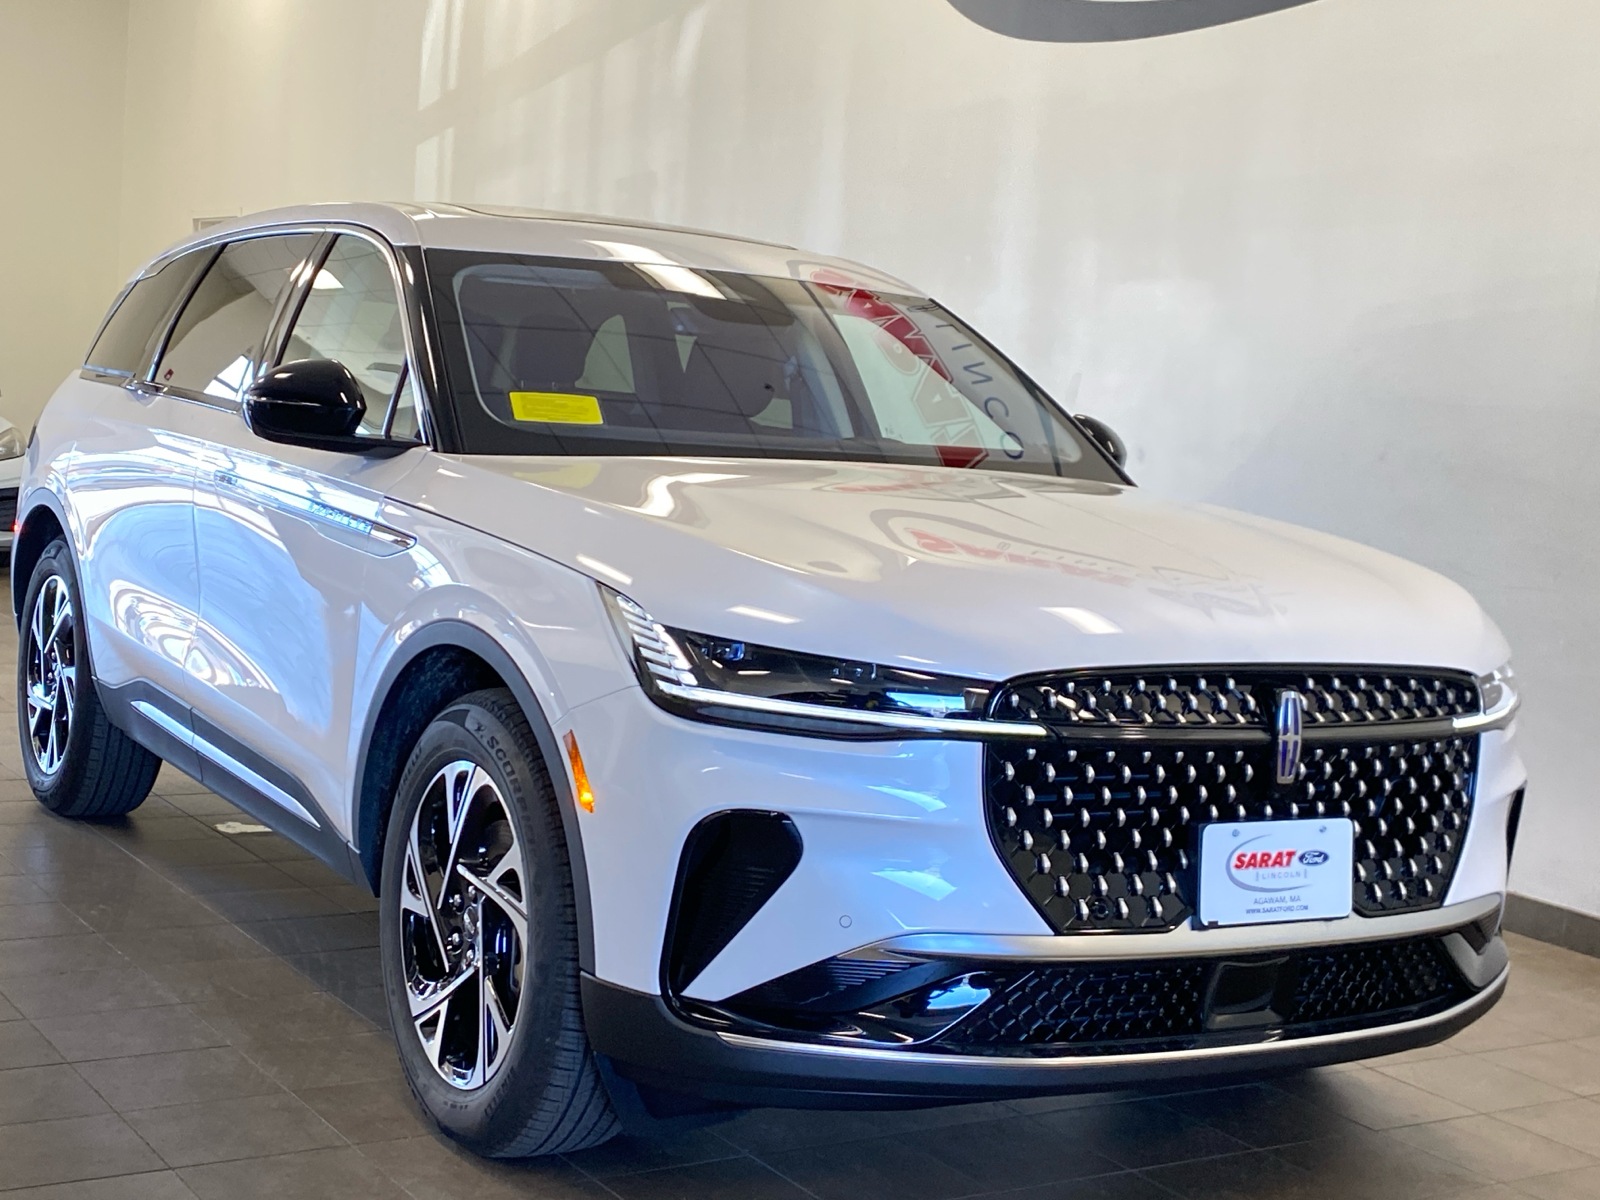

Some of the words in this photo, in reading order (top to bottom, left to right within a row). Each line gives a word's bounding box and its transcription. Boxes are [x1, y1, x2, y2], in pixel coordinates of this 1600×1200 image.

[485, 734, 537, 850] SCORPIO
[1234, 849, 1297, 870] SARAT
[1301, 851, 1327, 865] Ford
[1260, 871, 1302, 880] LINCOLN
[1289, 895, 1302, 903] MA
